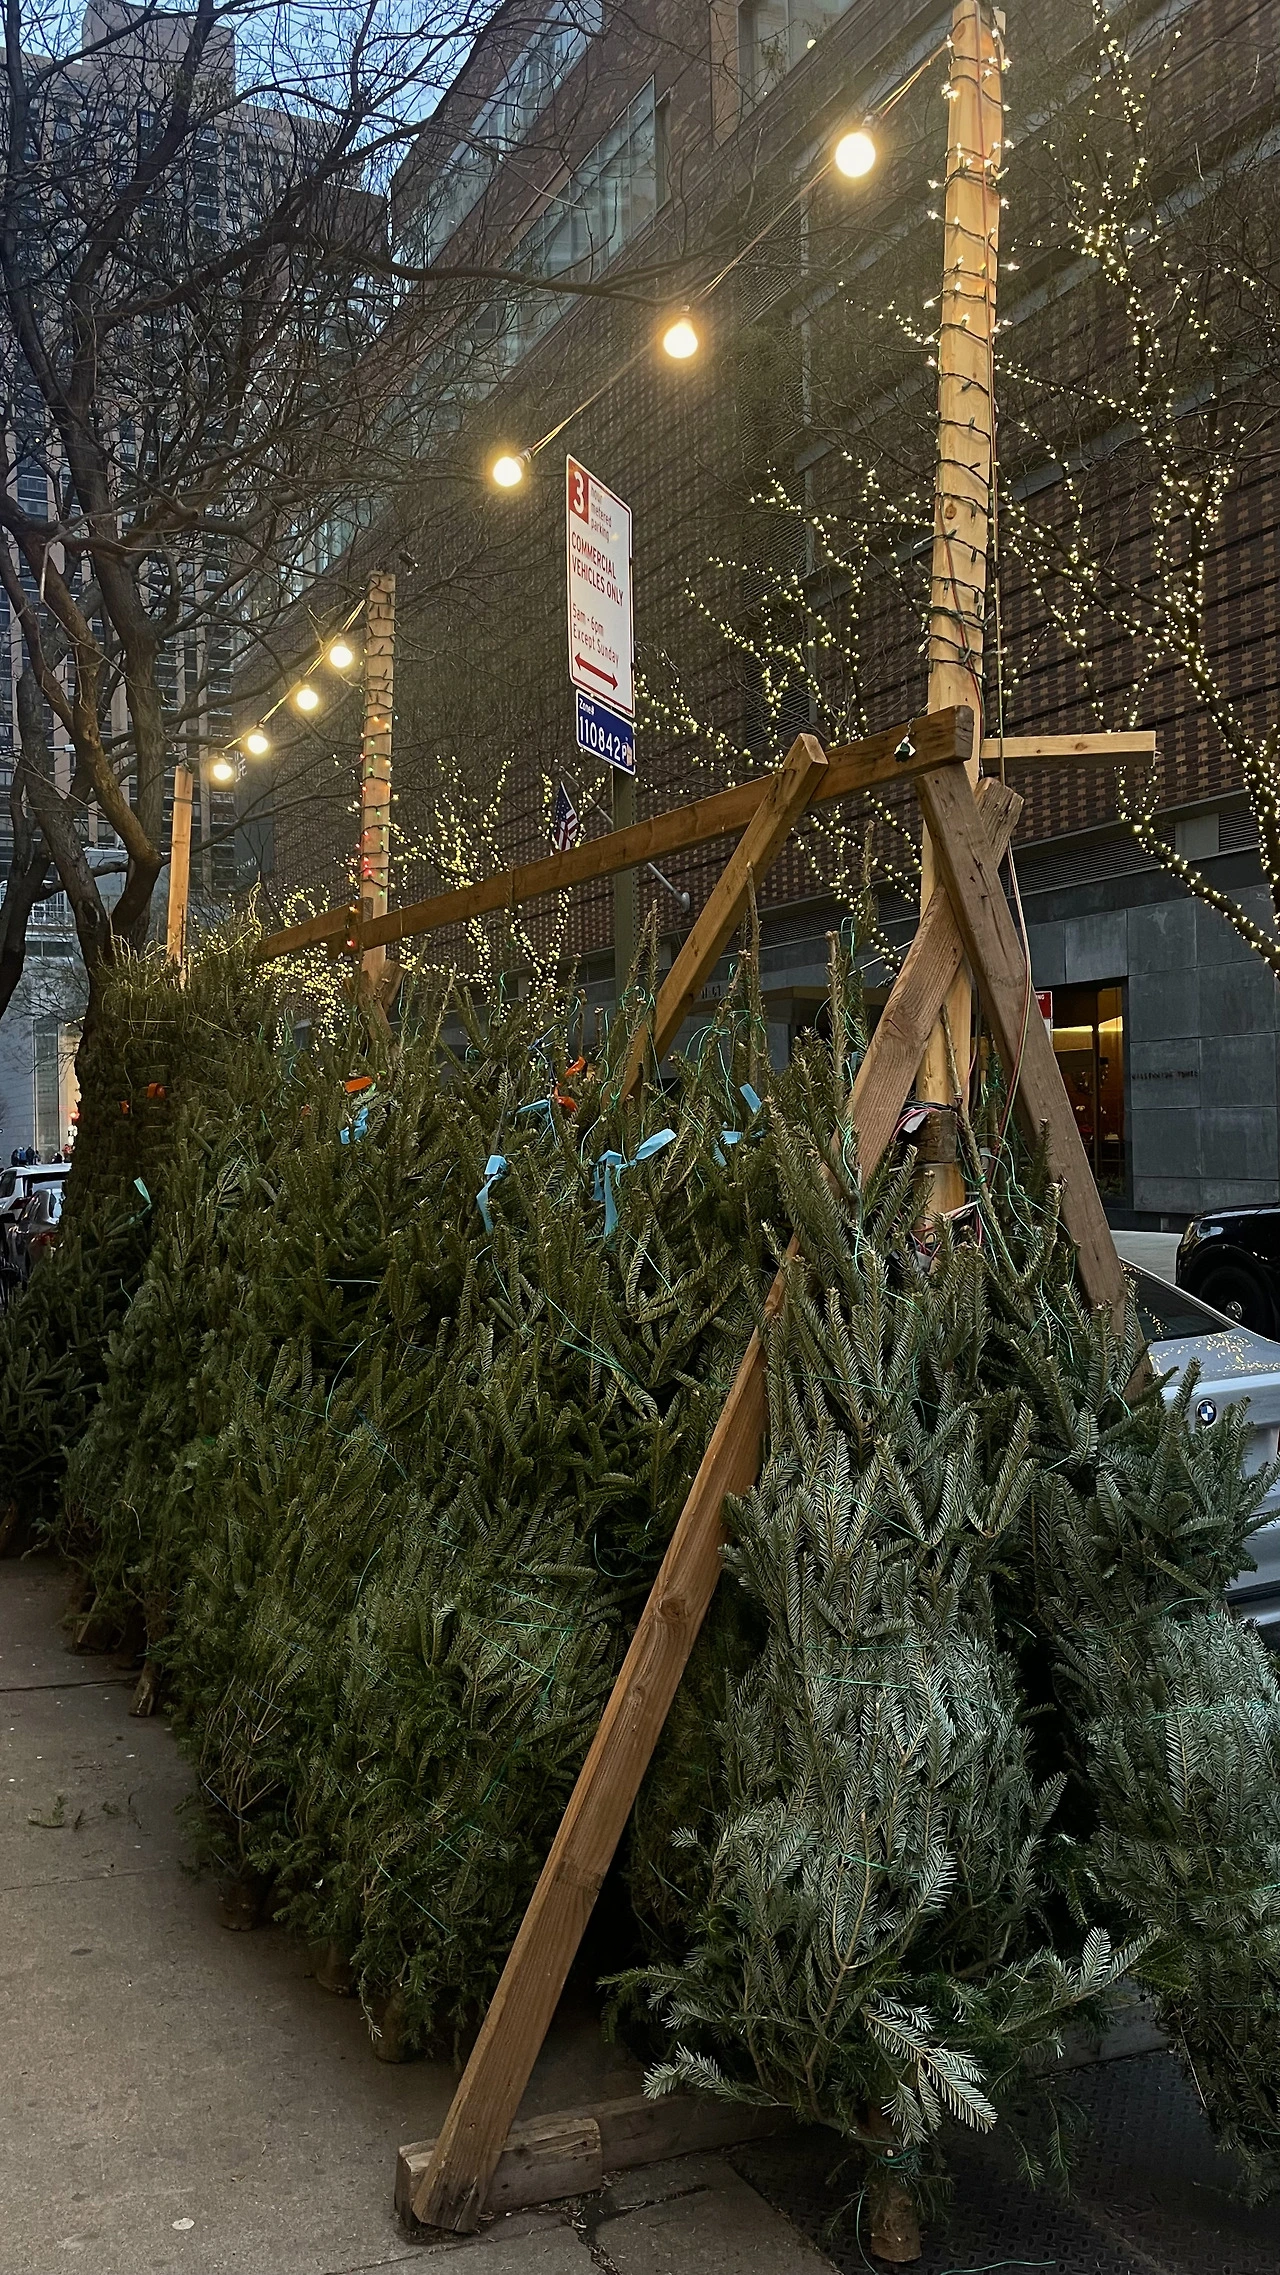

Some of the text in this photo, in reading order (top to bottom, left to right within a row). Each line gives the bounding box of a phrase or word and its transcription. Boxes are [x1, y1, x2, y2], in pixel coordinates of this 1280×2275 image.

[573, 471, 585, 514] 3
[591, 503, 612, 528] metered
[591, 518, 610, 543] parking
[572, 531, 616, 580] COMMERCIAL
[572, 554, 624, 607] VEHICLES ONLY
[573, 623, 619, 669] Except Sunday
[580, 715, 621, 762] 110842
